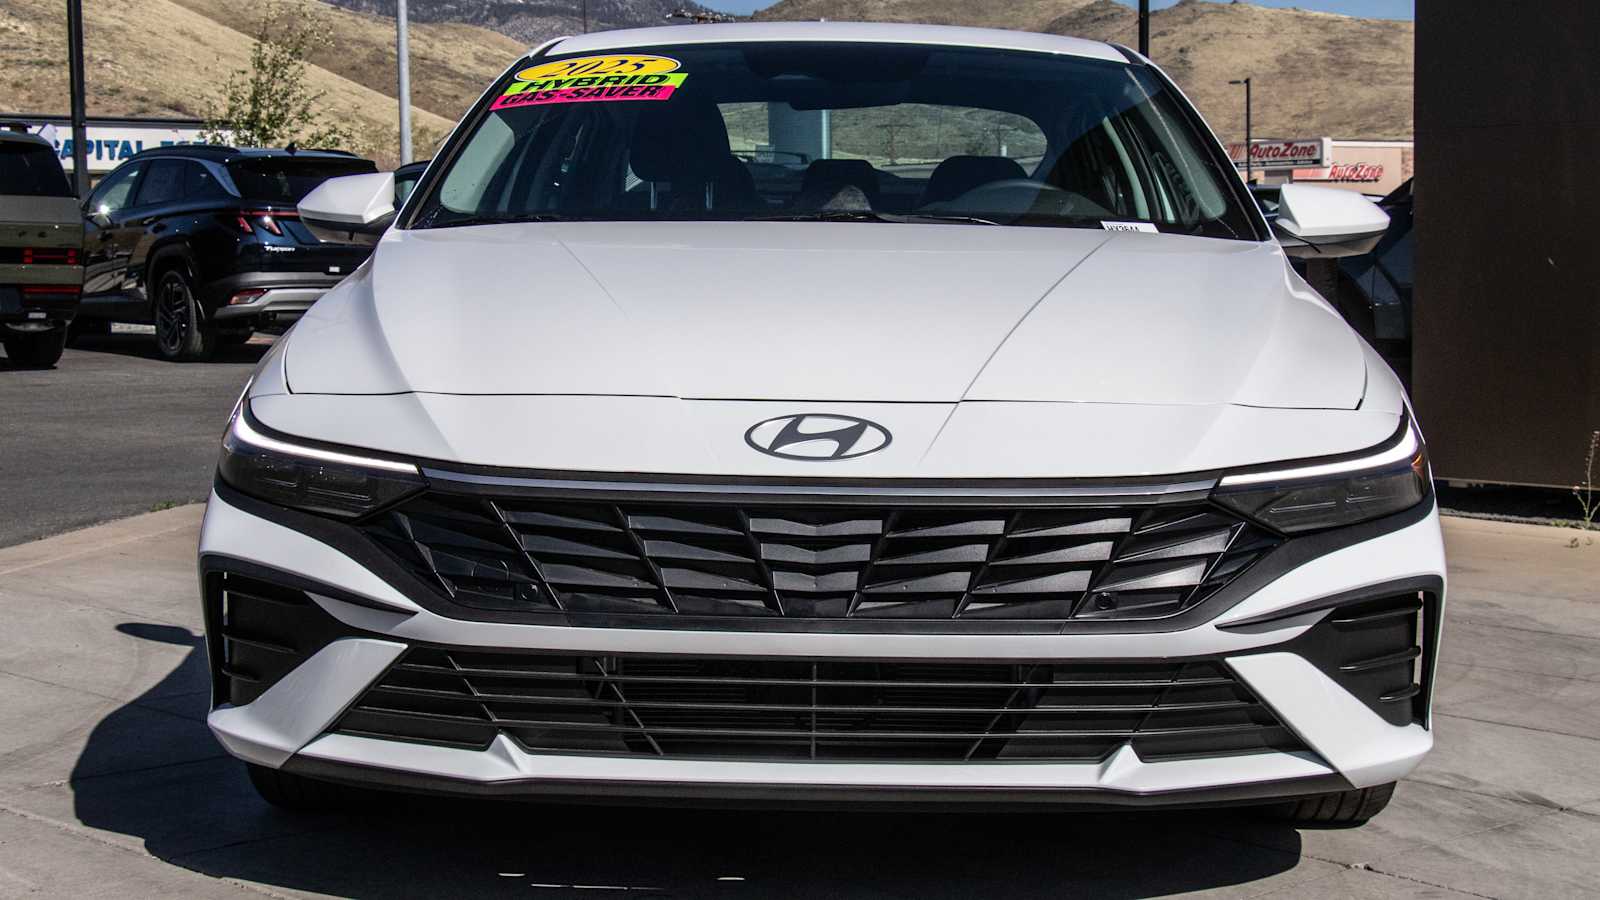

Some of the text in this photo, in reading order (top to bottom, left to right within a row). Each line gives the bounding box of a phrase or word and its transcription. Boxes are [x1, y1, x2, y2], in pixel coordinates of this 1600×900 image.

[537, 59, 657, 78] 2025
[521, 74, 668, 91] HYBRID
[501, 85, 664, 104] GAS-SAVER
[54, 139, 143, 161] APITAL
[1250, 143, 1317, 159] AutoZone
[1328, 164, 1384, 180] AutoZone
